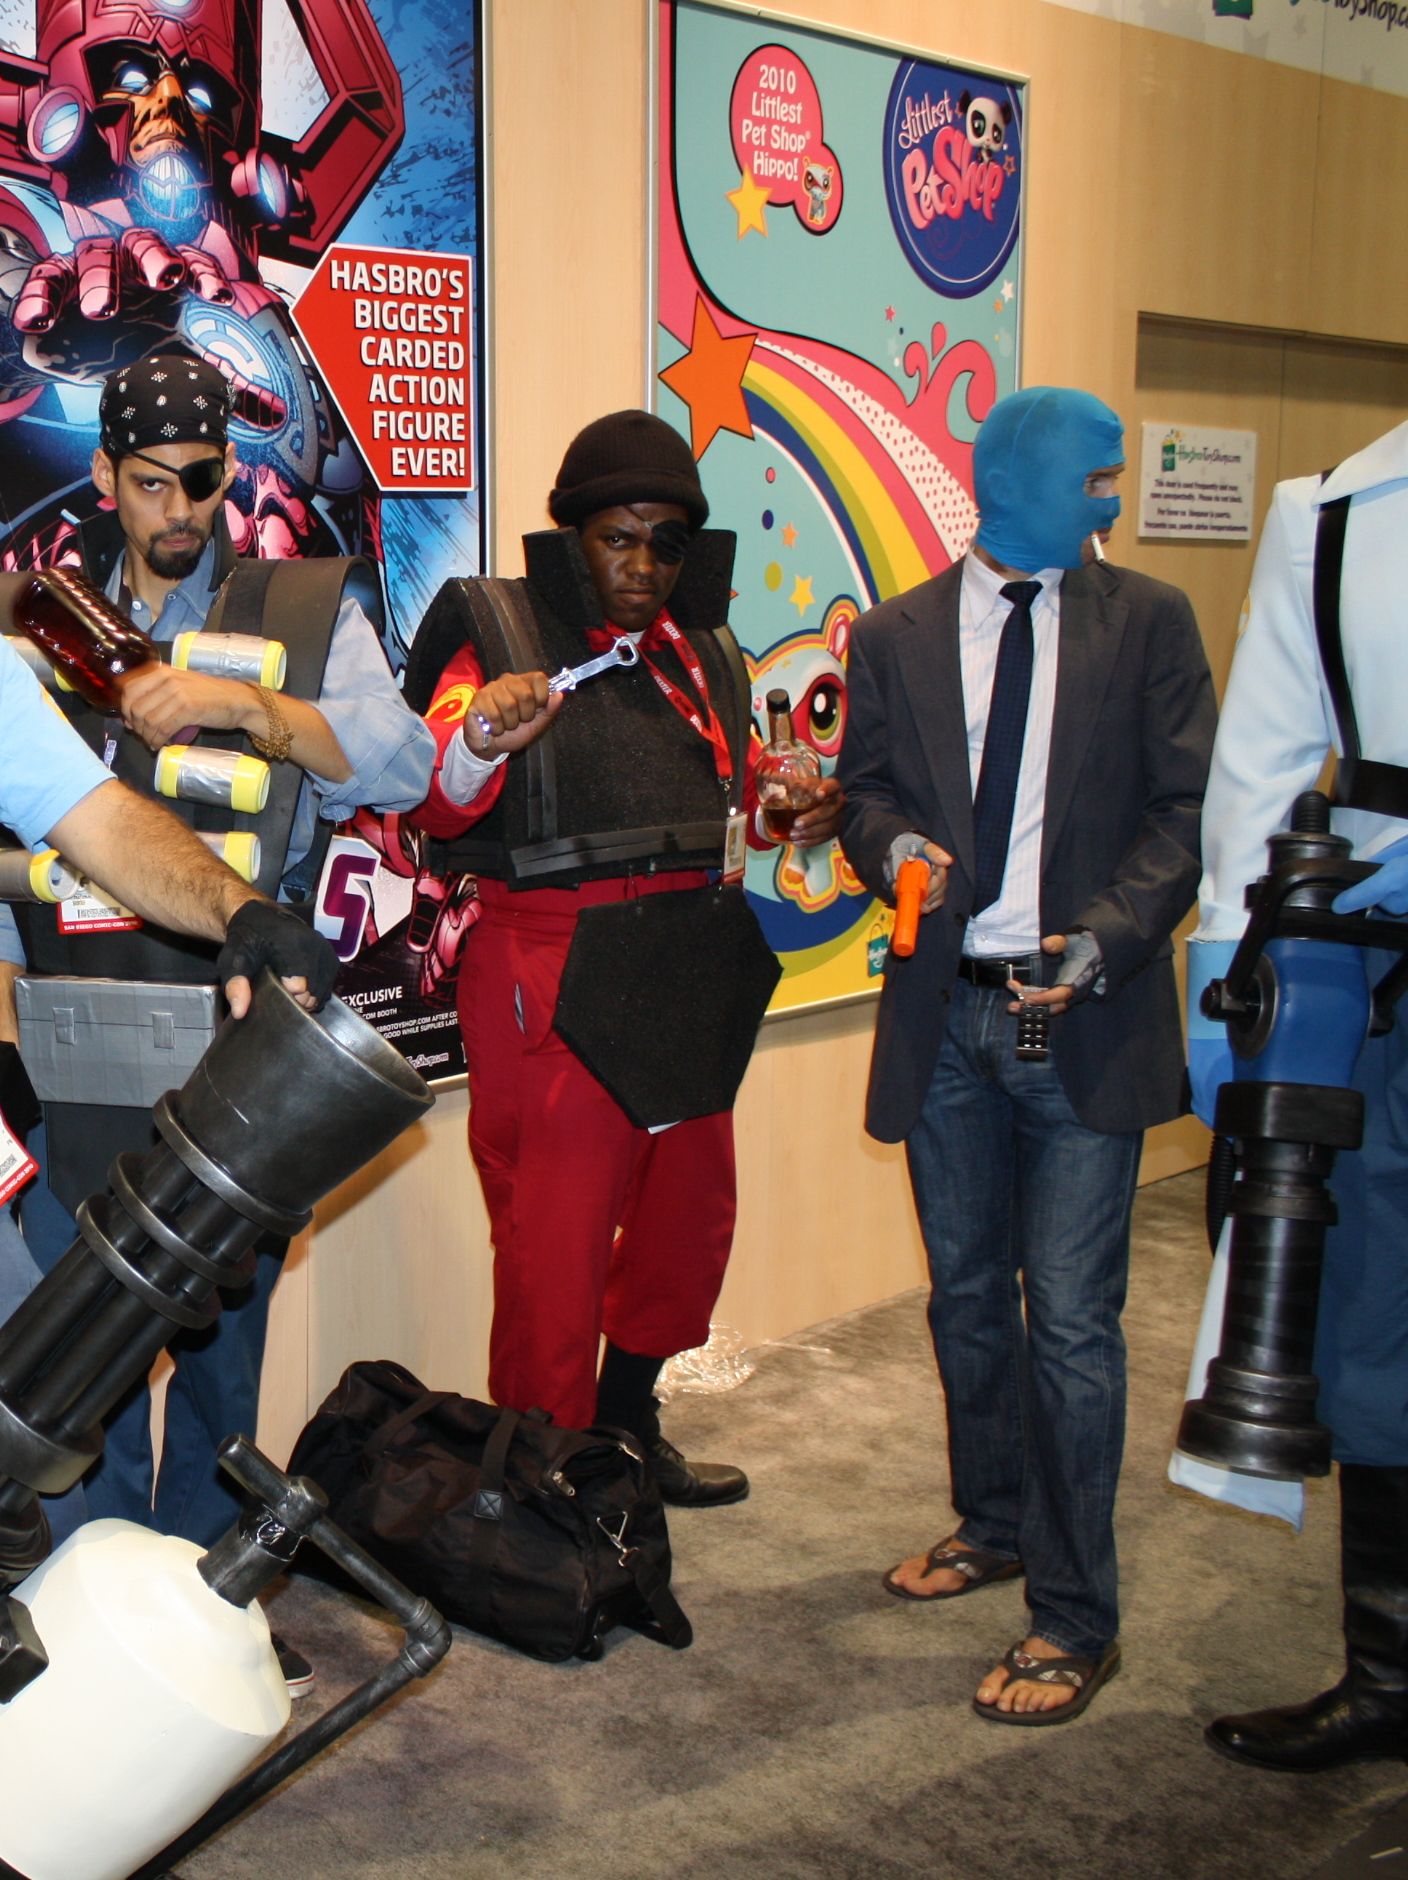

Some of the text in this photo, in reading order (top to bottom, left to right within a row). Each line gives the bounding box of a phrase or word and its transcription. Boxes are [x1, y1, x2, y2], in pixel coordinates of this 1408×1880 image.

[759, 64, 797, 94] 2010
[751, 92, 803, 125] Littlest
[898, 89, 955, 149] Littlest
[742, 119, 768, 146] Pet
[753, 151, 799, 182] Hippo!
[902, 125, 1005, 230] Pet Shop
[330, 260, 464, 299] HASBRO'S
[354, 299, 465, 335] BIGGEST
[360, 336, 465, 371] CARDED
[369, 374, 465, 406] ACTION
[373, 410, 465, 441] FIGURE
[392, 447, 465, 476] EVER!
[377, 1008, 398, 1018] BOOTH
[420, 1021, 445, 1032] SUPPLIES
